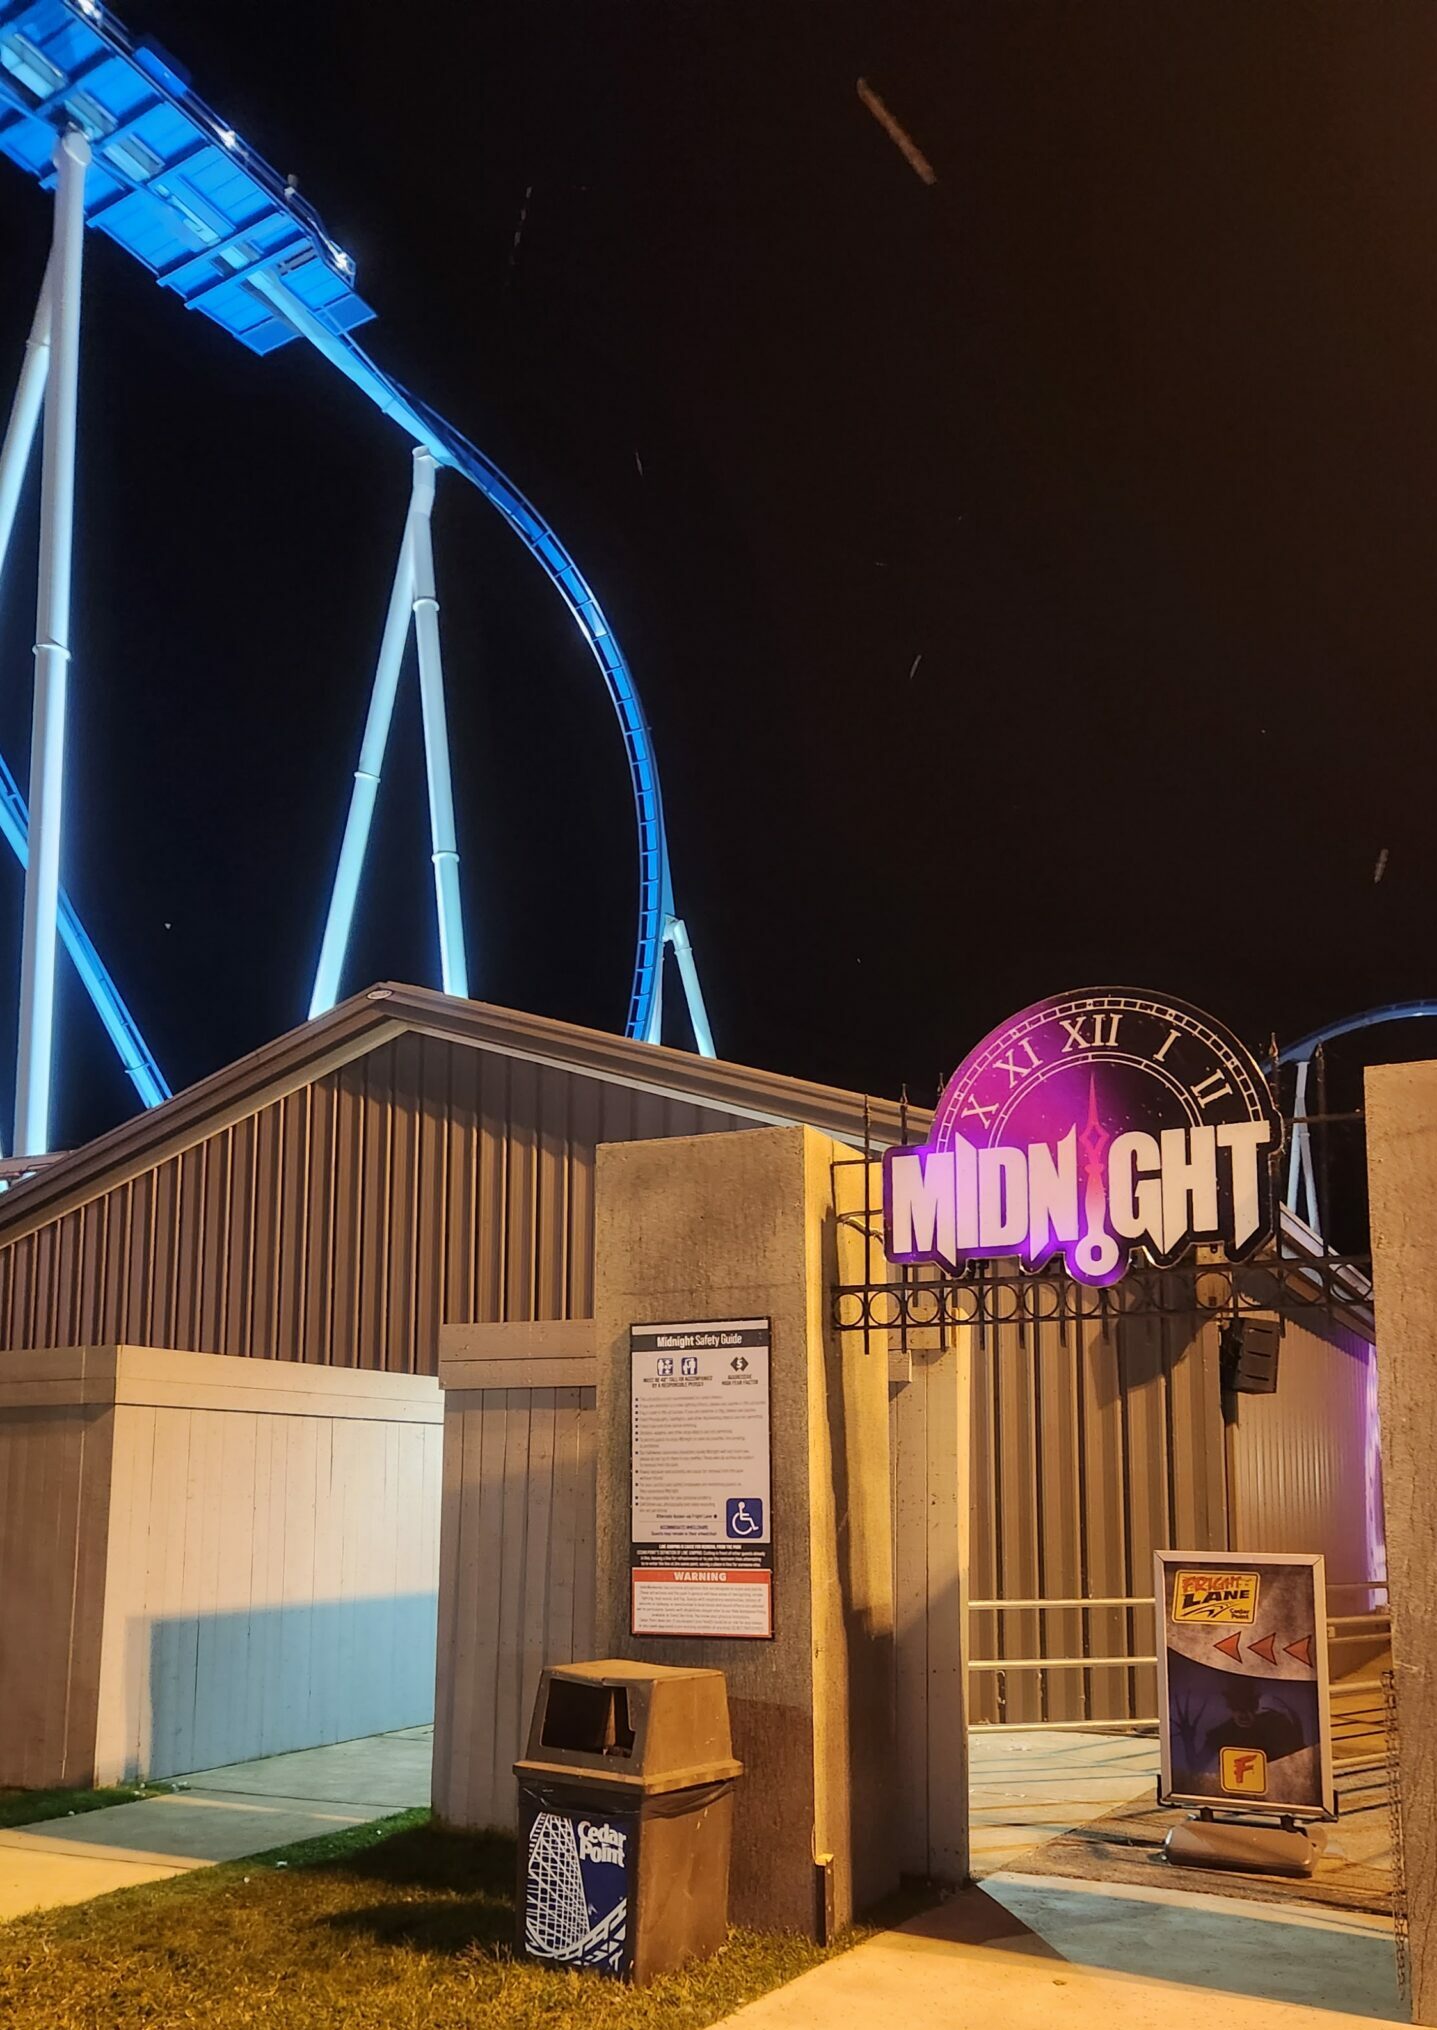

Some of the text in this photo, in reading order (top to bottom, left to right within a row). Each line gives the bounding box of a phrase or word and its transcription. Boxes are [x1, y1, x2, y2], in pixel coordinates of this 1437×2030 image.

[992, 1036, 1043, 1090] XI
[1059, 1013, 1123, 1053] XII
[1189, 1067, 1234, 1109] II
[891, 1120, 1270, 1275] MIDNIGHT
[657, 1333, 743, 1348] Midnight Safety Guide
[674, 1572, 727, 1581] WARNING
[1182, 1576, 1242, 1593] FRIGHT
[1182, 1590, 1250, 1609] LANE
[1233, 1754, 1258, 1787] F
[577, 1820, 627, 1848] Cedar
[579, 1839, 626, 1868] Point
